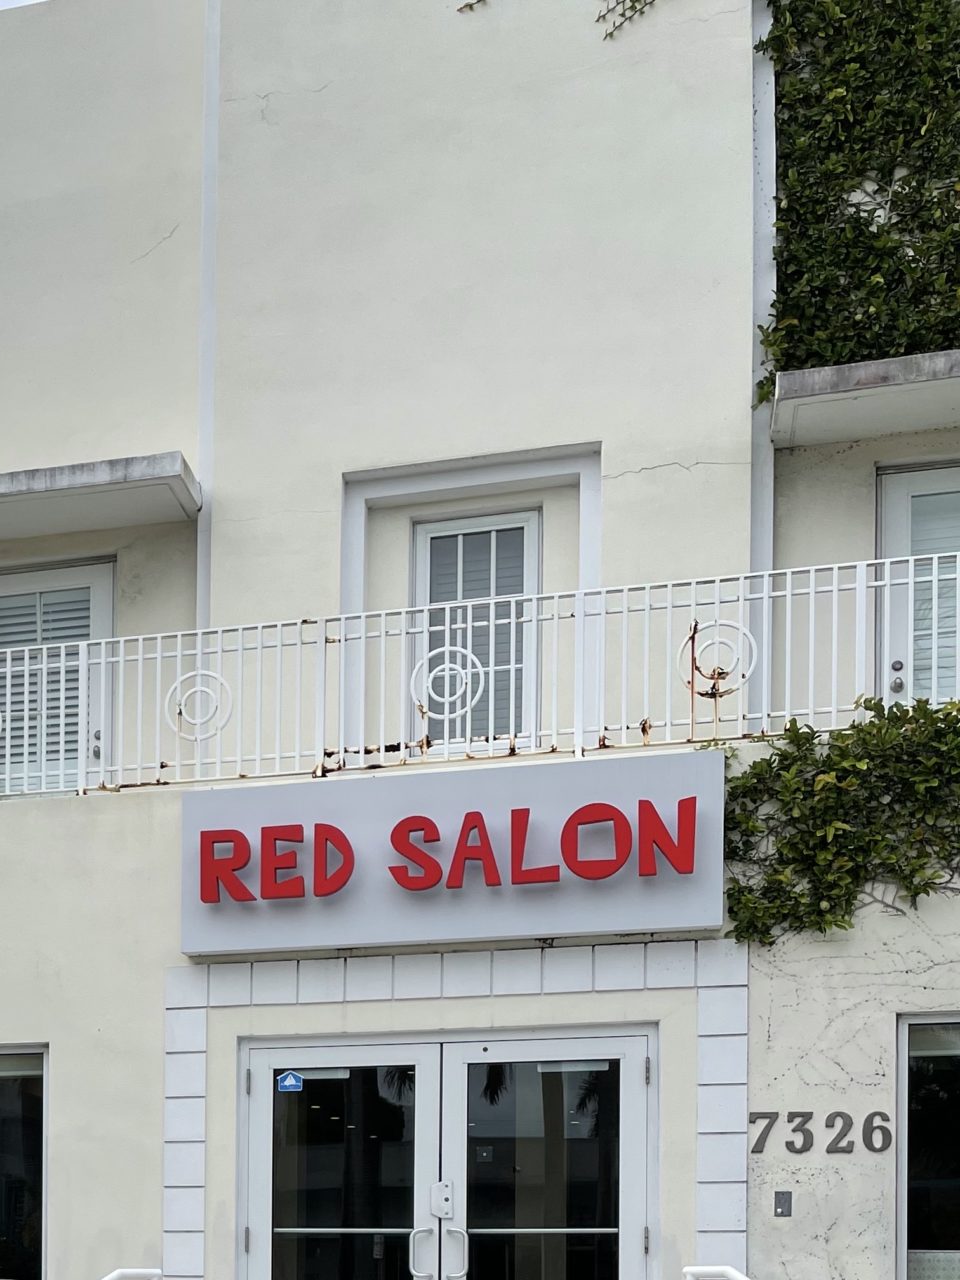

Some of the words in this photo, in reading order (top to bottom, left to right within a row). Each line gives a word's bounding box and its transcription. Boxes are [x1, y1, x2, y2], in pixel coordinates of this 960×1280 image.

[200, 823, 355, 904] RED
[388, 796, 697, 891] SALON
[748, 1111, 893, 1154] 7326
